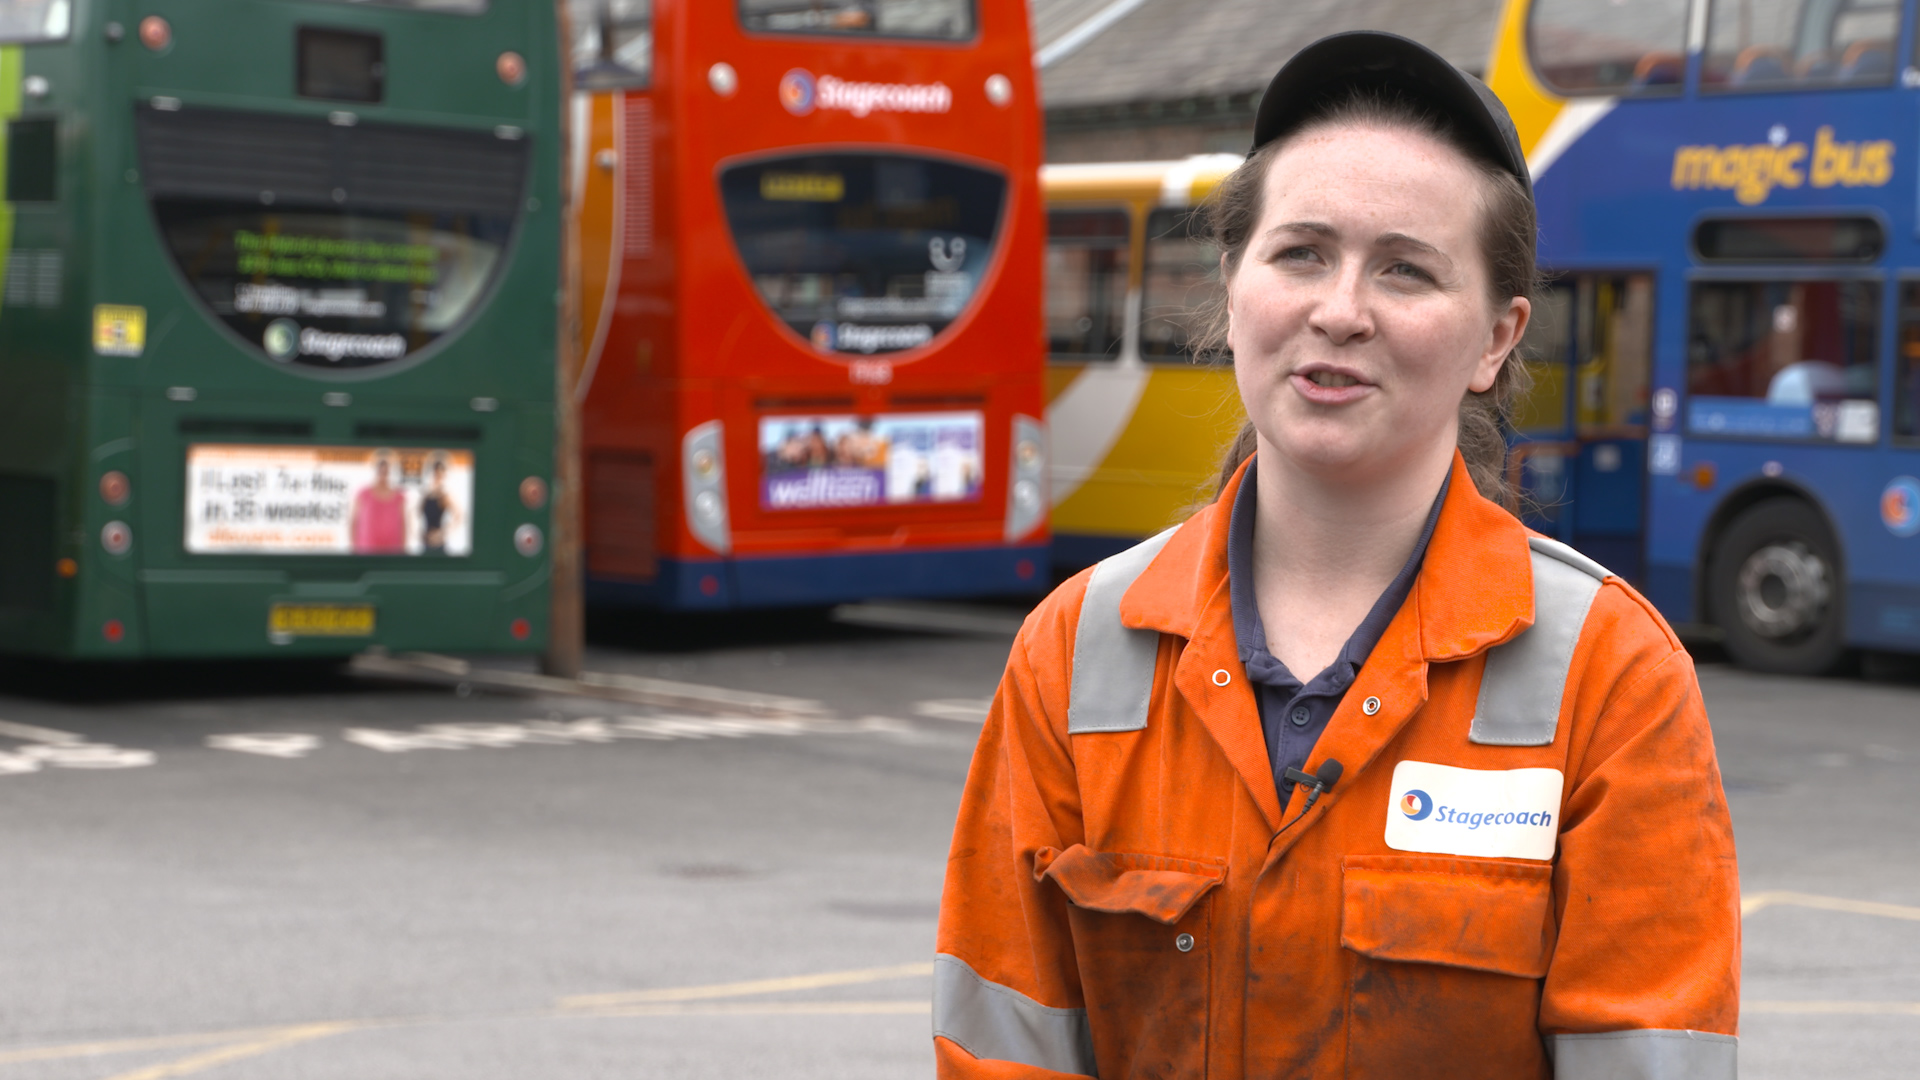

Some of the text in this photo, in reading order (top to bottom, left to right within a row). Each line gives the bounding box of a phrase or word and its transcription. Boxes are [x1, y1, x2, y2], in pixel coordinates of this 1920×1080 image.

[817, 77, 951, 116] Stagecoach
[1672, 127, 1893, 204] magic bus
[1435, 805, 1552, 830] Stagecoach
